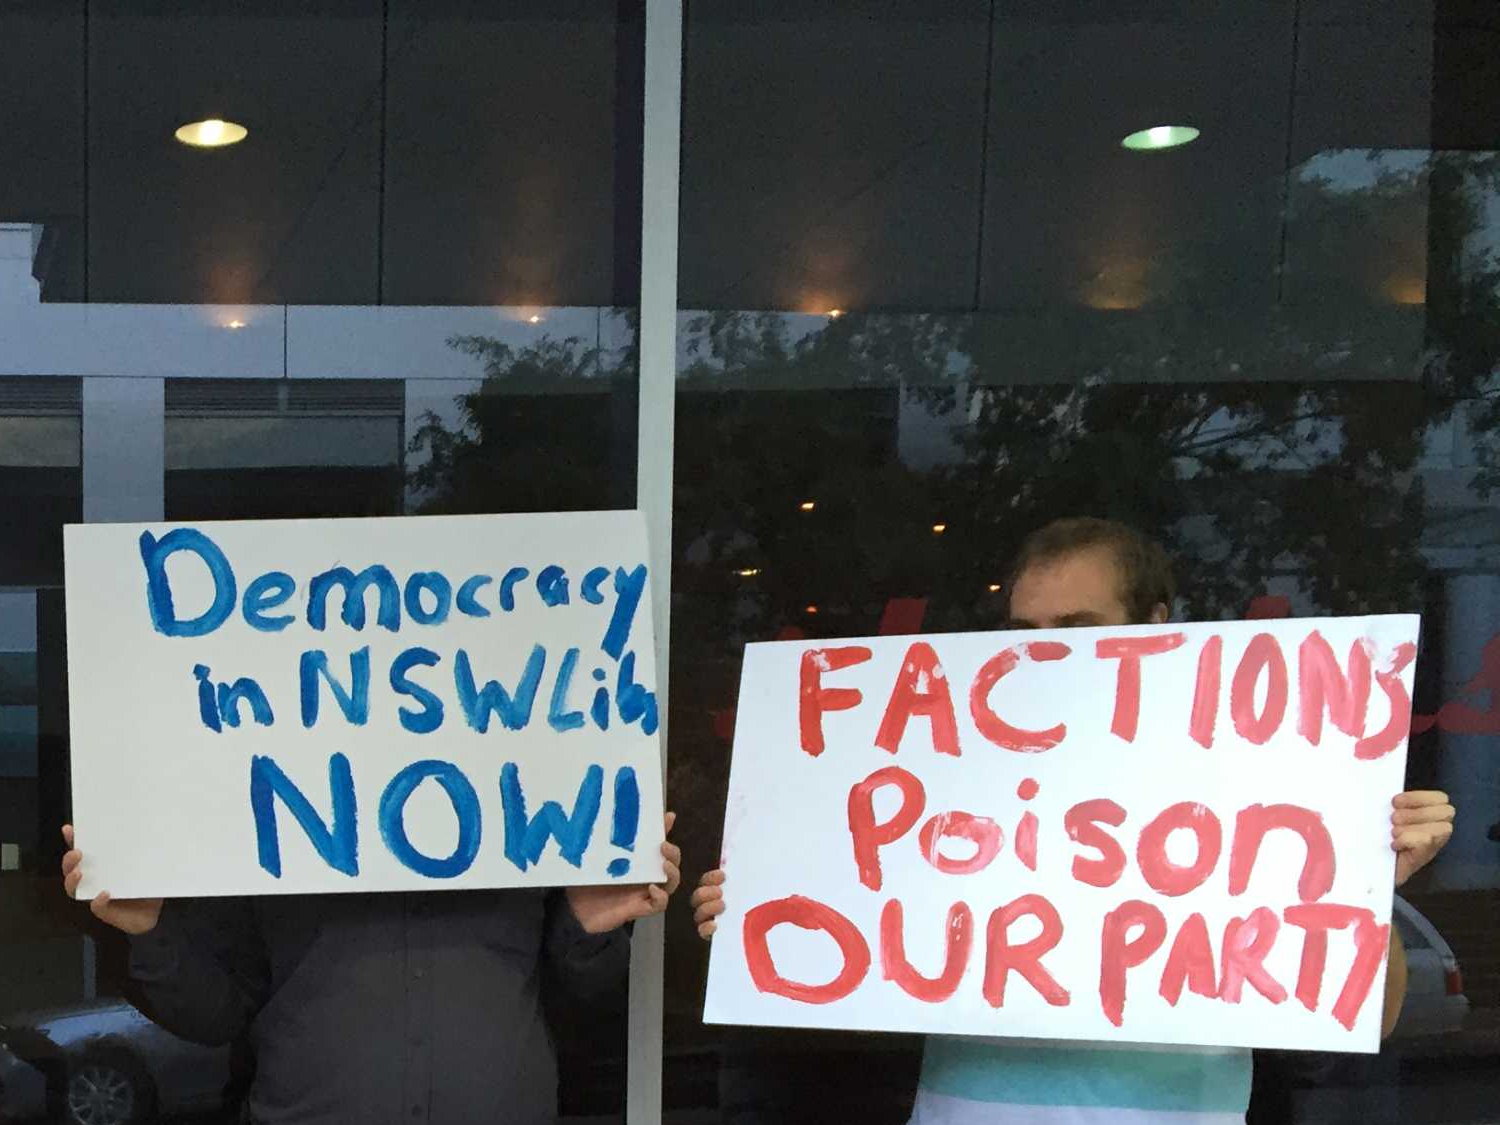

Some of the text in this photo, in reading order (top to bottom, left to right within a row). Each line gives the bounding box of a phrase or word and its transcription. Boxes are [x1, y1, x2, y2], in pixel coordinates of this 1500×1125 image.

[140, 528, 647, 661] Democracy
[193, 664, 274, 733] in
[798, 629, 1417, 760] FACTIONS
[250, 752, 641, 879] NOW!
[847, 766, 1337, 903] Poison
[742, 893, 1391, 1032] OUR PARTY
